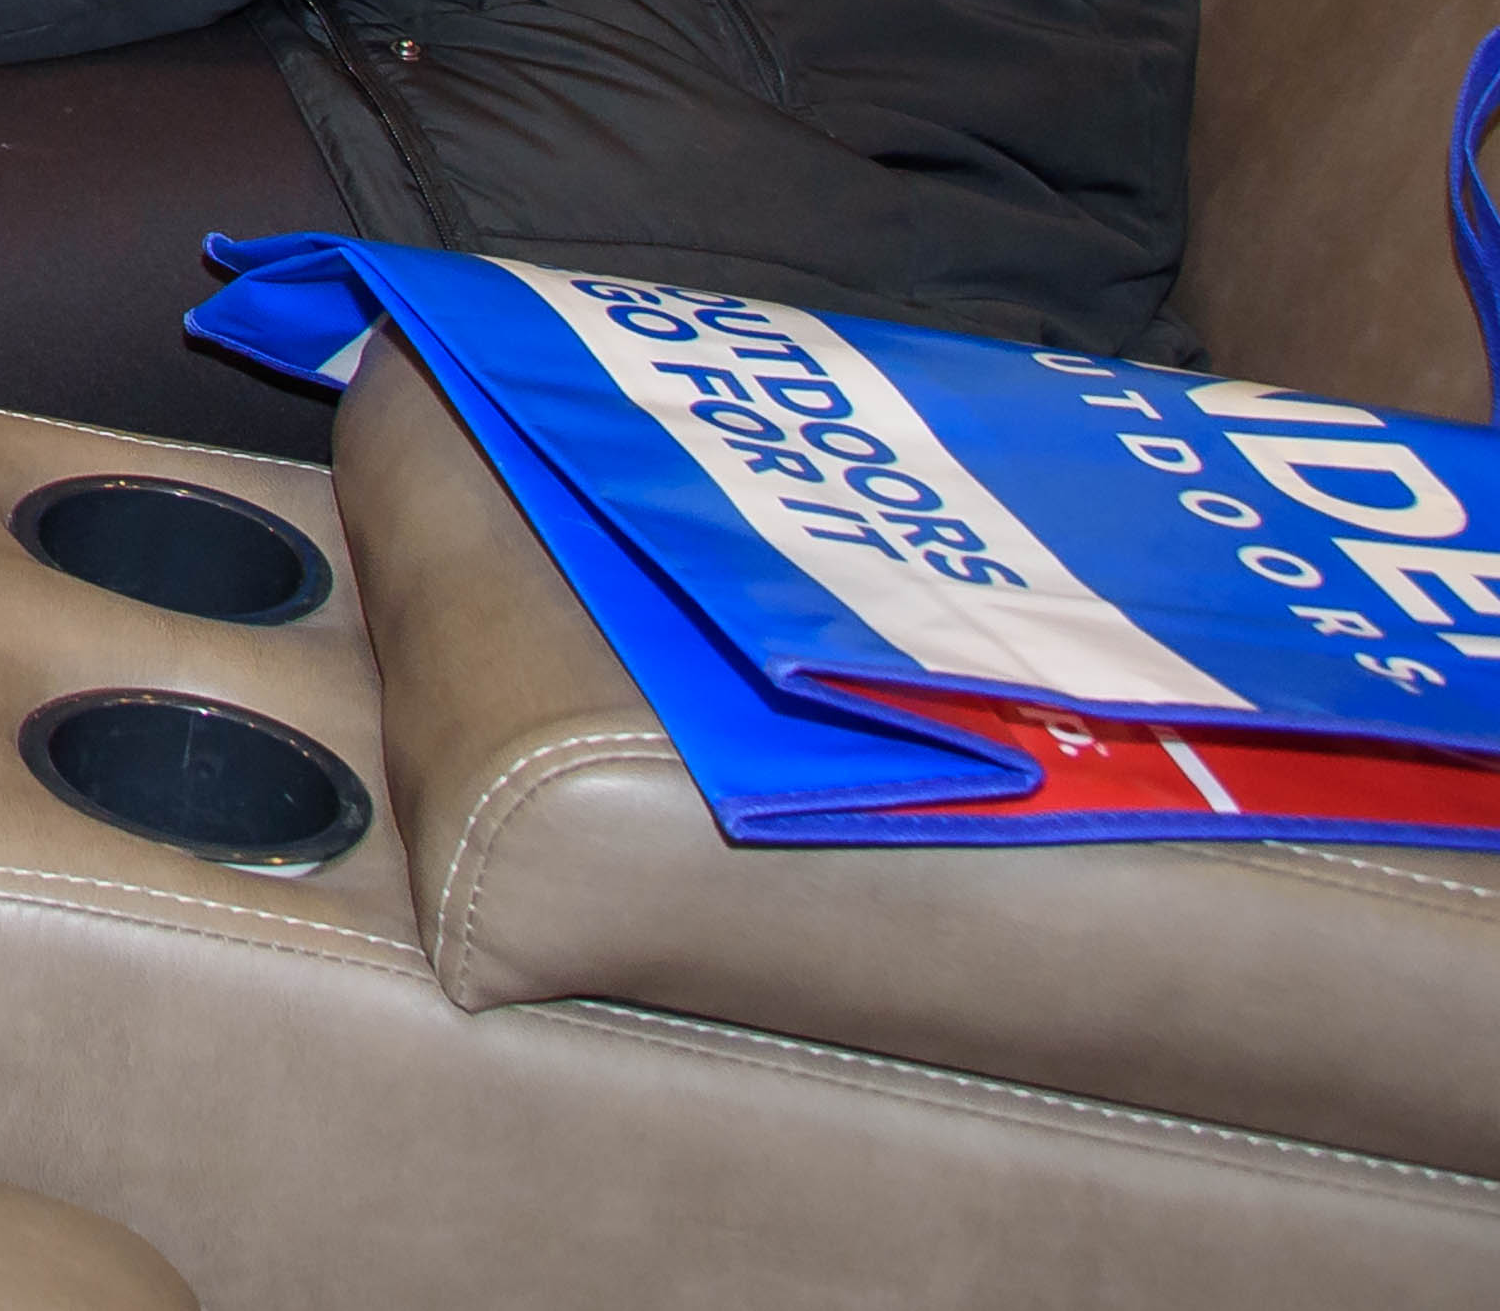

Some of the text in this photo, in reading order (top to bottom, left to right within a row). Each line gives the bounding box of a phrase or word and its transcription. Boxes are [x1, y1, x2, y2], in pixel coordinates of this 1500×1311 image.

[570, 279, 906, 561] GO FOR IT
[654, 286, 1029, 591] OUTDOORS
[1031, 352, 1446, 686] UTDOORS
